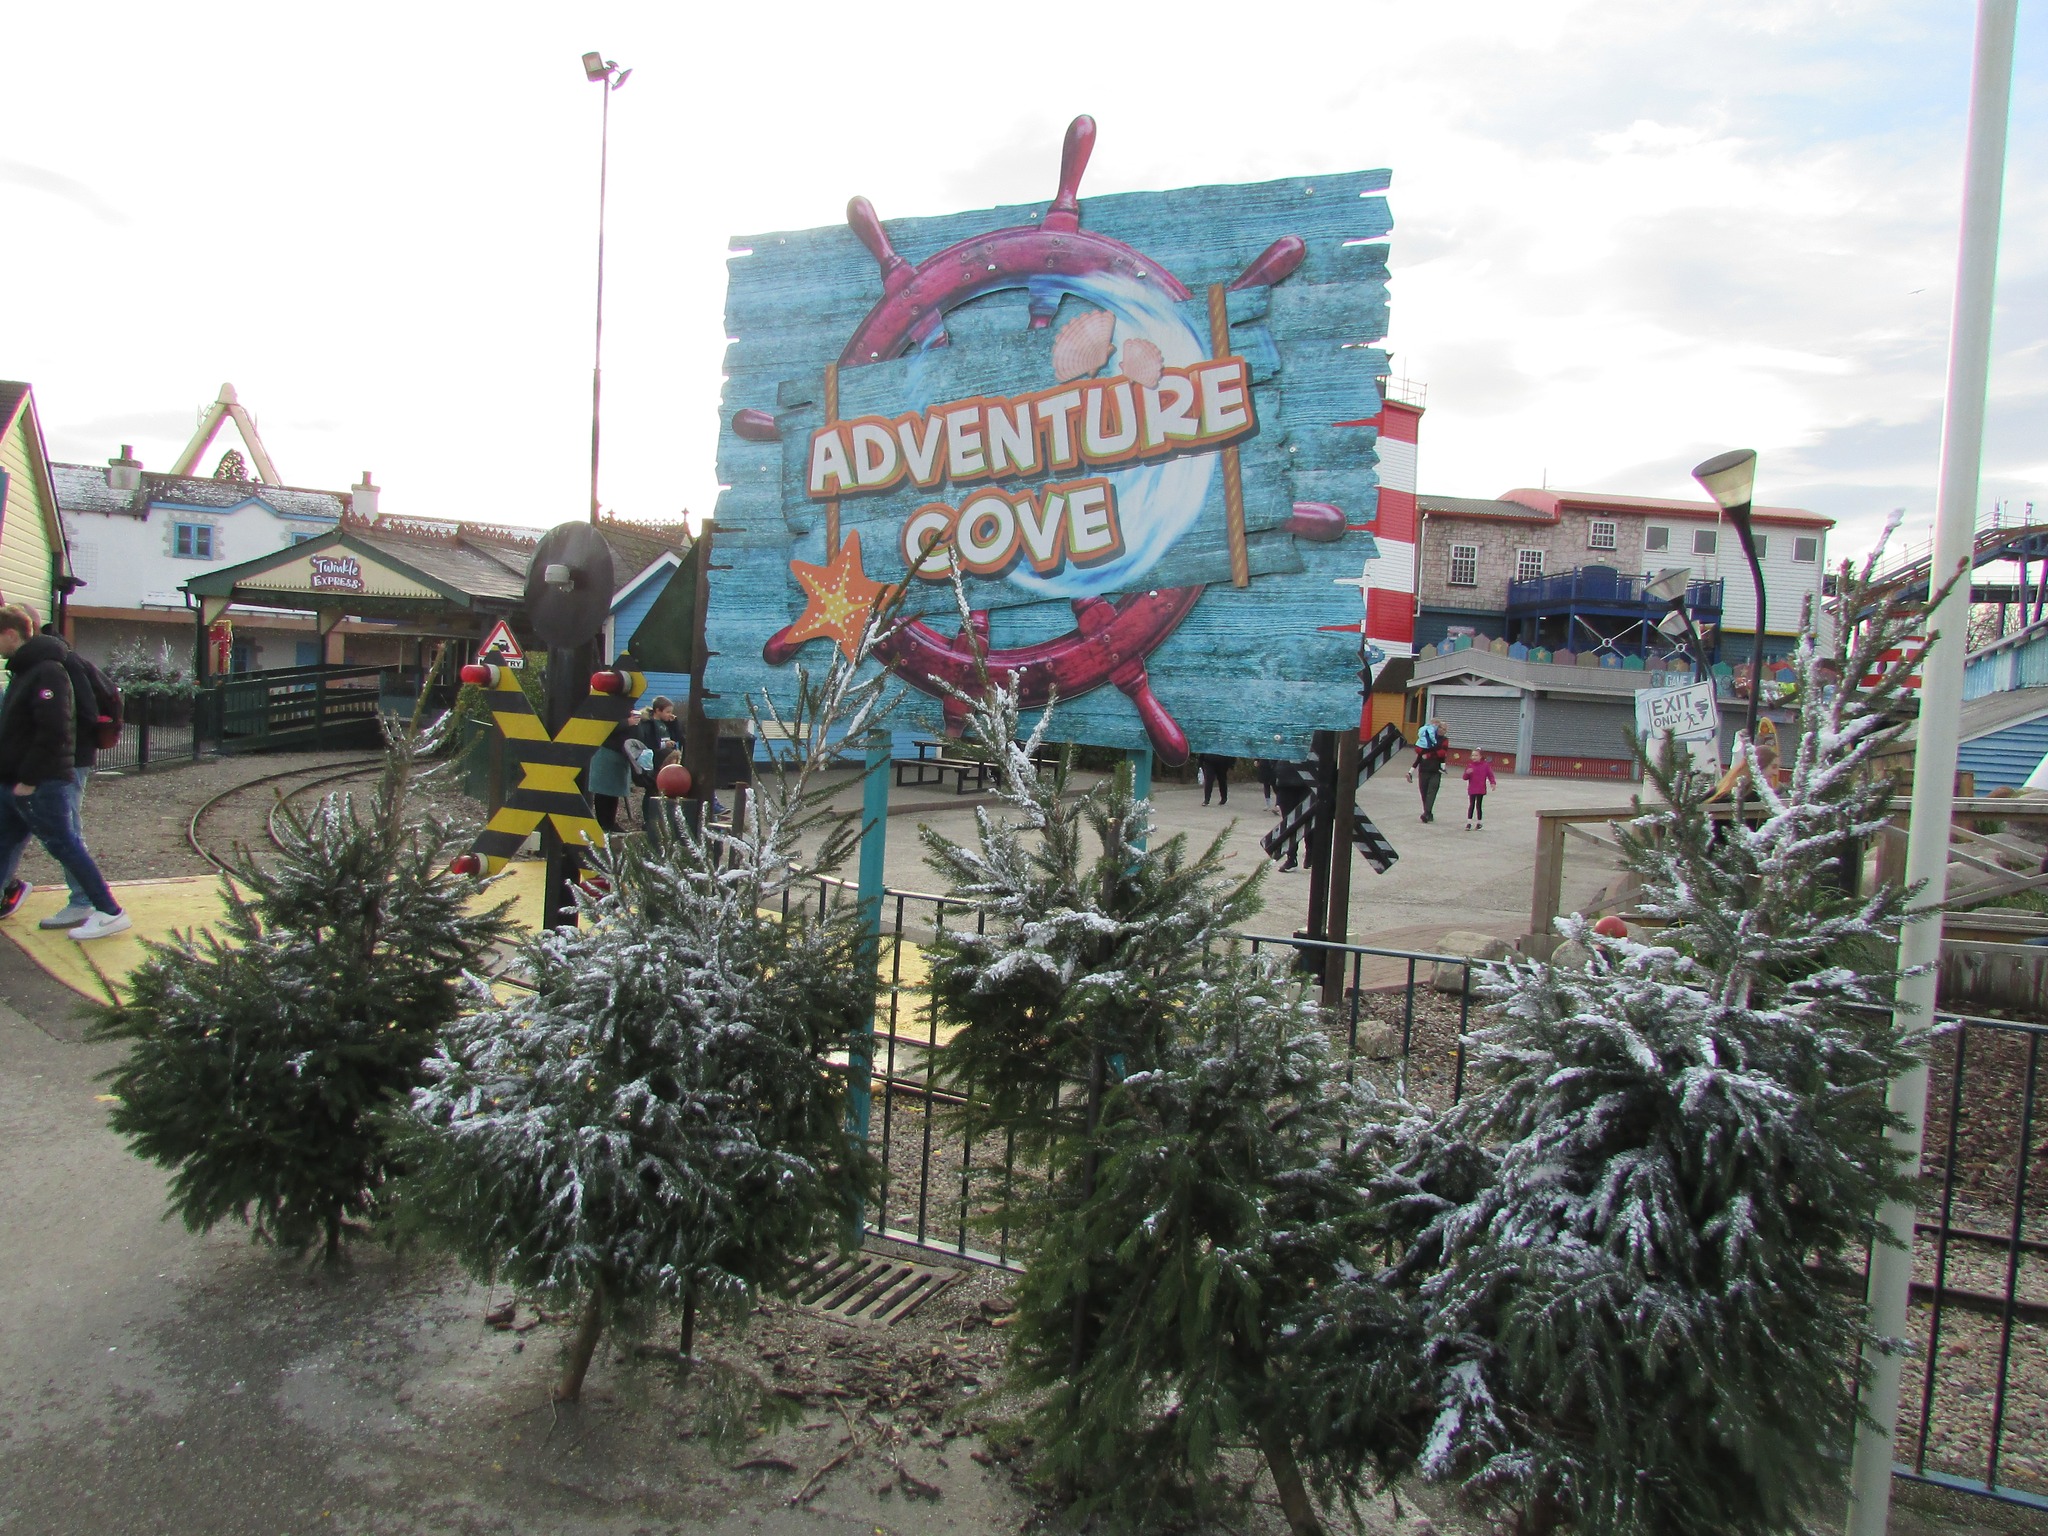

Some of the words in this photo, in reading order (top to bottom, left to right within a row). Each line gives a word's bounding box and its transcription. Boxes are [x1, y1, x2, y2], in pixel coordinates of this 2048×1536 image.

[809, 363, 1250, 492] ADVENTURE
[904, 486, 1113, 573] COVE
[316, 559, 359, 576] Twinkle
[313, 575, 359, 589] EXPRESS
[1651, 691, 1692, 716] EXIT
[1653, 712, 1682, 728] ONLY
